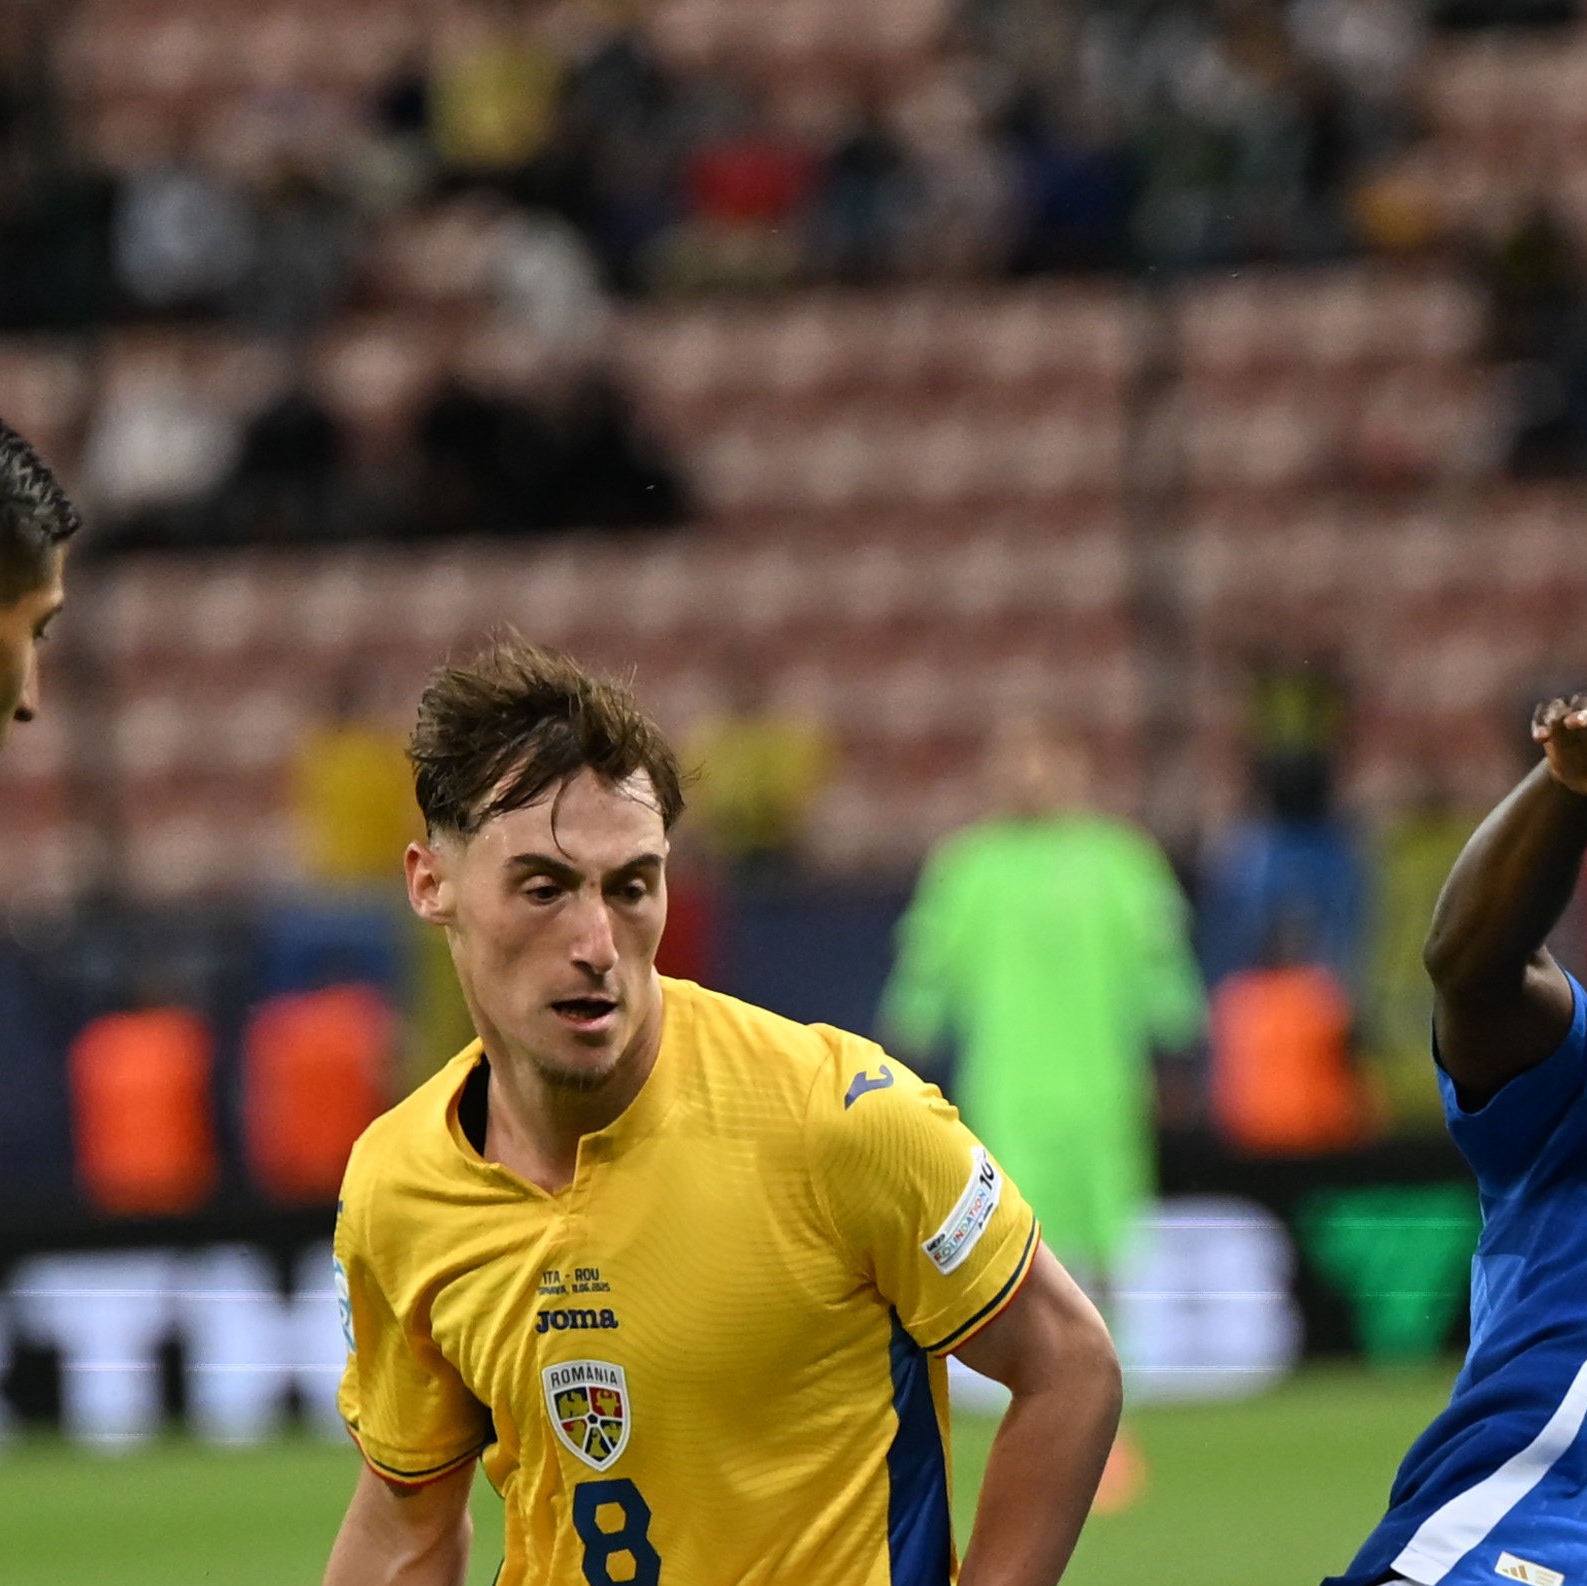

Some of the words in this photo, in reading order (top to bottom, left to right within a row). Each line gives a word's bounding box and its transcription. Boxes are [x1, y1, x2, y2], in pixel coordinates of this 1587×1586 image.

[933, 1188, 988, 1264] FOUNDATION
[542, 1270, 561, 1285] ITA
[574, 1267, 600, 1282] ROU
